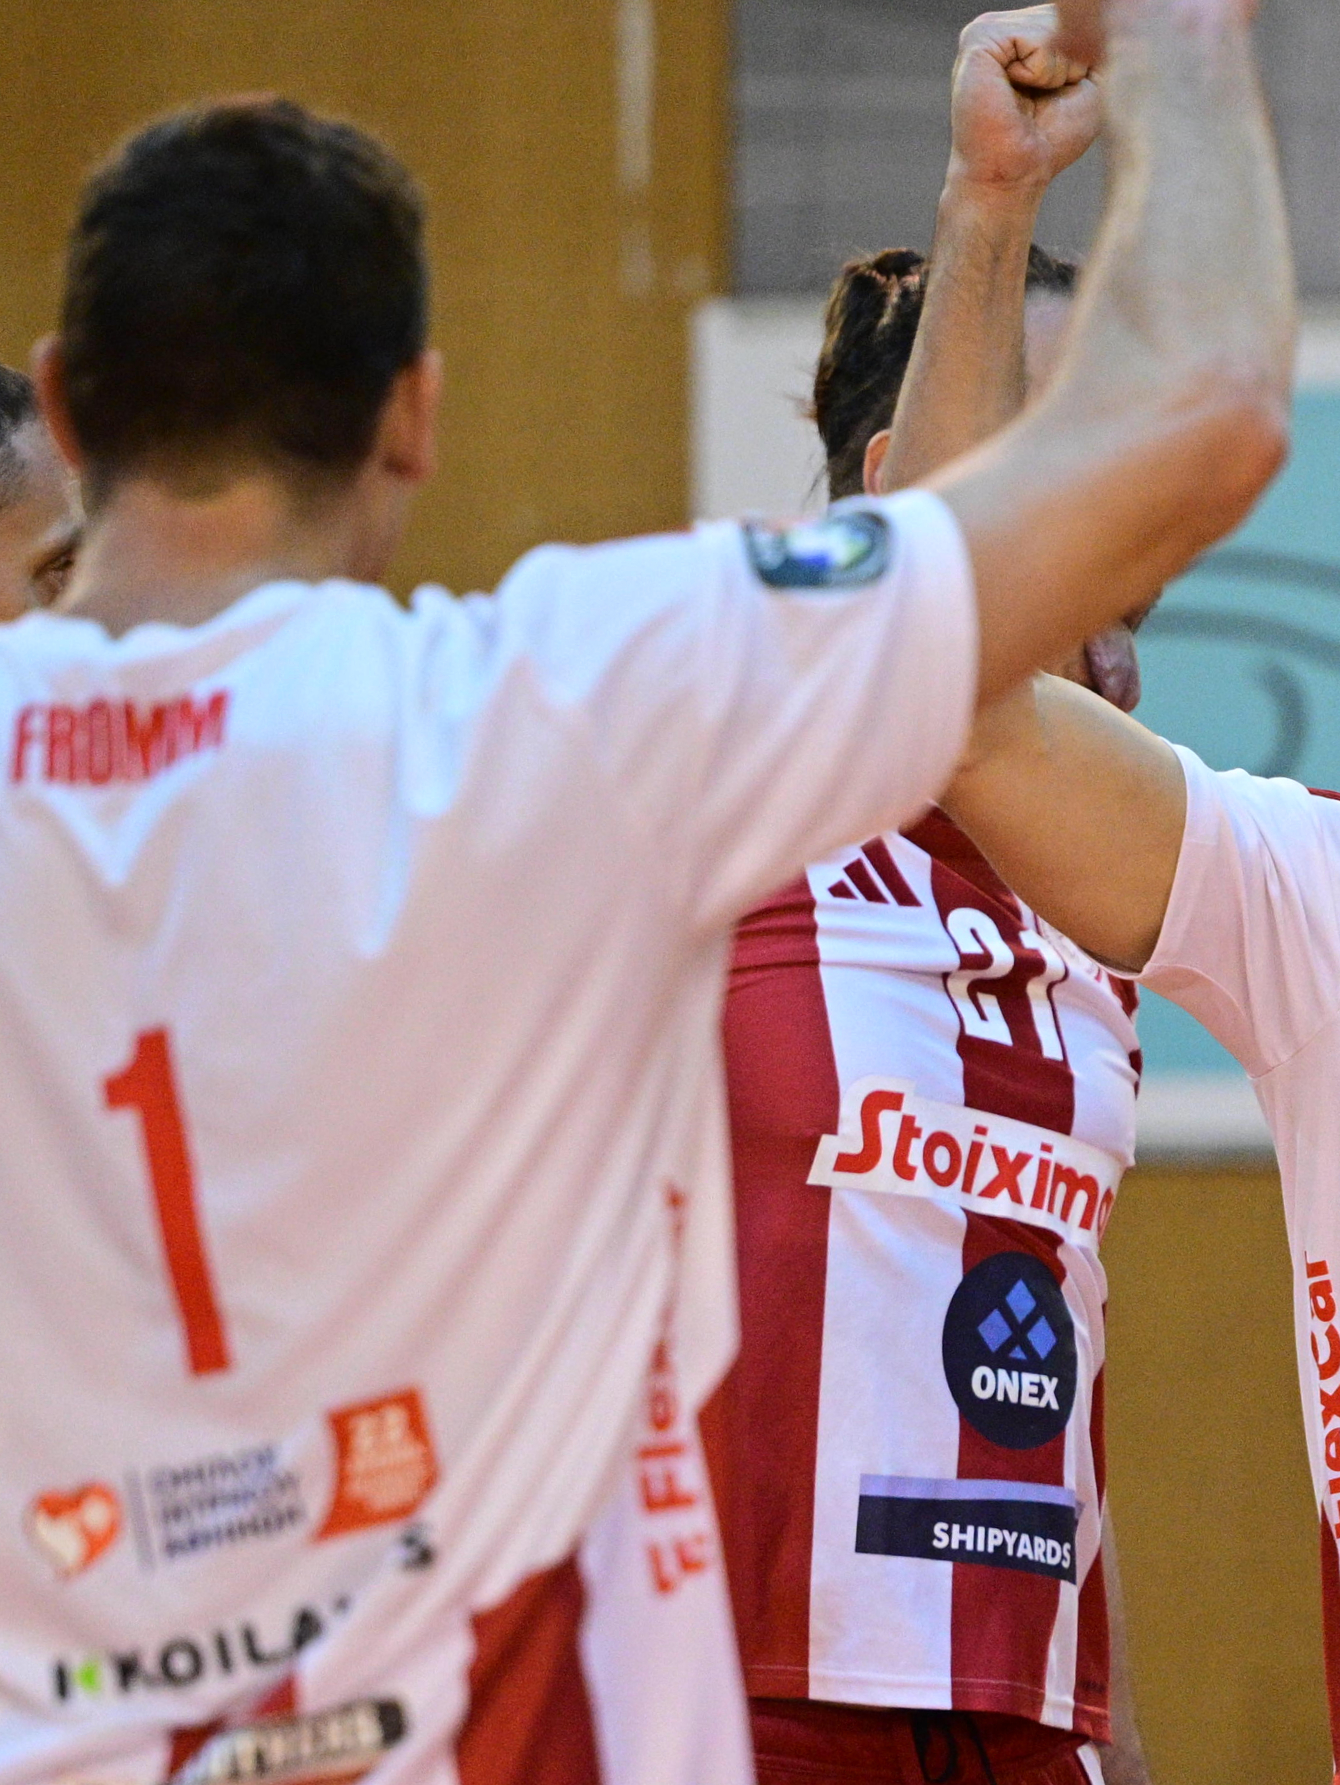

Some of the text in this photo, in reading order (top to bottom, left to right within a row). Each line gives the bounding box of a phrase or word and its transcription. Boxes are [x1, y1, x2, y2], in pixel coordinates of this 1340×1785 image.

[9, 687, 232, 786] FROMM
[945, 906, 1065, 1063] 21
[102, 1026, 233, 1376] 1
[971, 1364, 1061, 1412] ONEX
[931, 1520, 1072, 1570] SHIPYARDS
